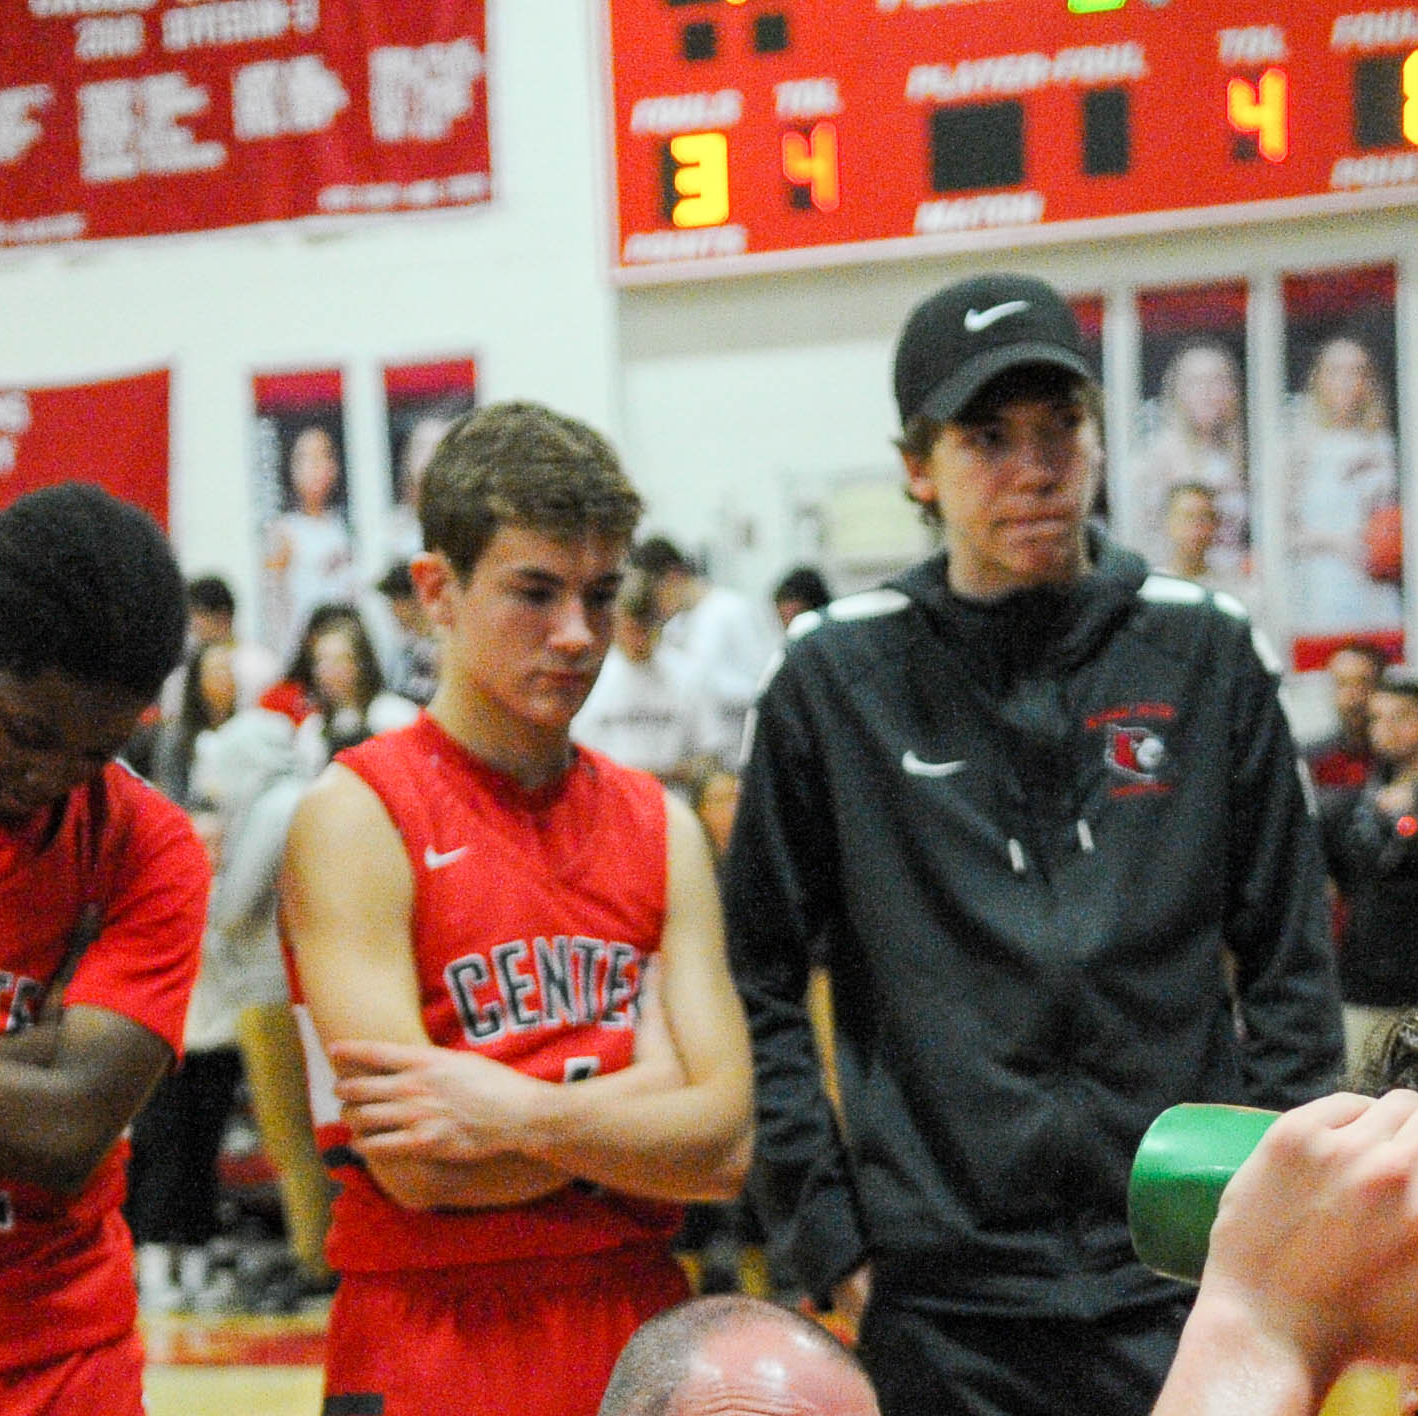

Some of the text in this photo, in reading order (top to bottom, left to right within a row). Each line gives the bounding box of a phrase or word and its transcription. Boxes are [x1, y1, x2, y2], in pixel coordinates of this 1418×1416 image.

[1226, 66, 1289, 164] 4
[670, 132, 730, 229] 3
[781, 120, 842, 214] 4
[444, 935, 645, 1045] CENTE
